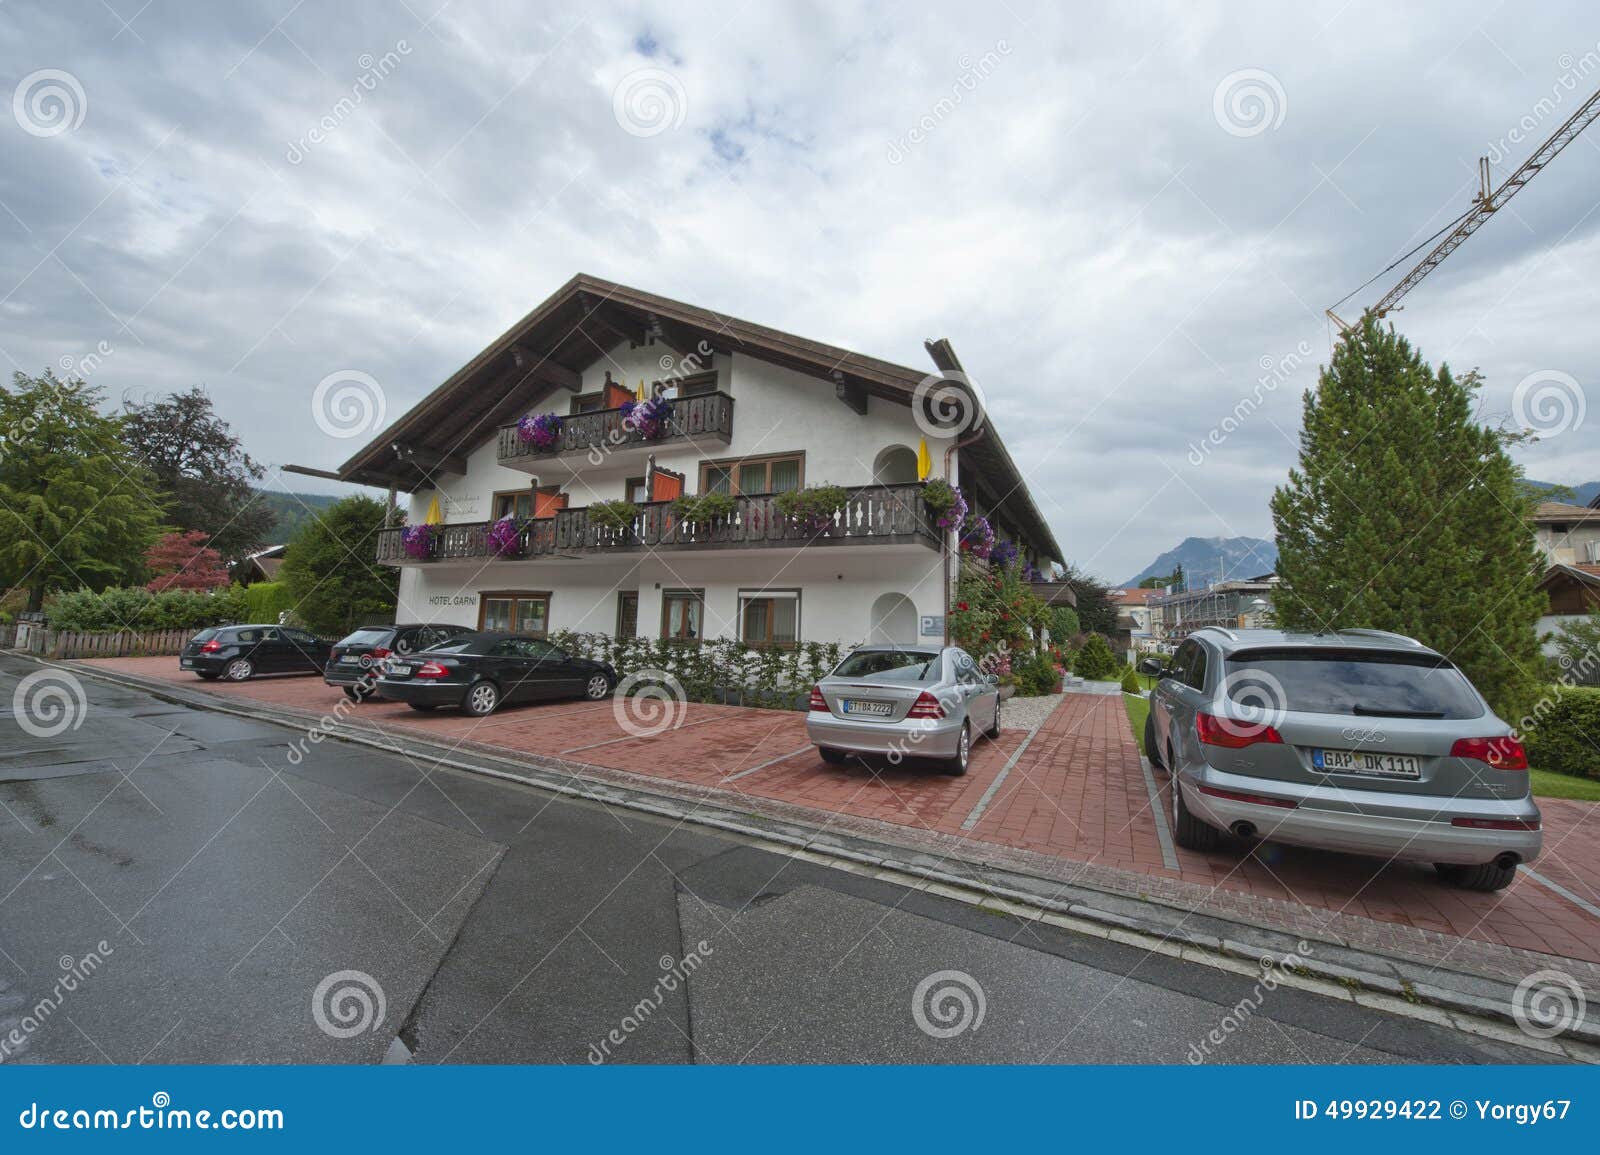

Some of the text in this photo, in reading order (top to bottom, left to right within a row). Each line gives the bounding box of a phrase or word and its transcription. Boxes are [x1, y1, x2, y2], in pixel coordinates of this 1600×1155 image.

[429, 596, 477, 606] HOTEL GARNI
[1324, 752, 1417, 774] GAP DK 111
